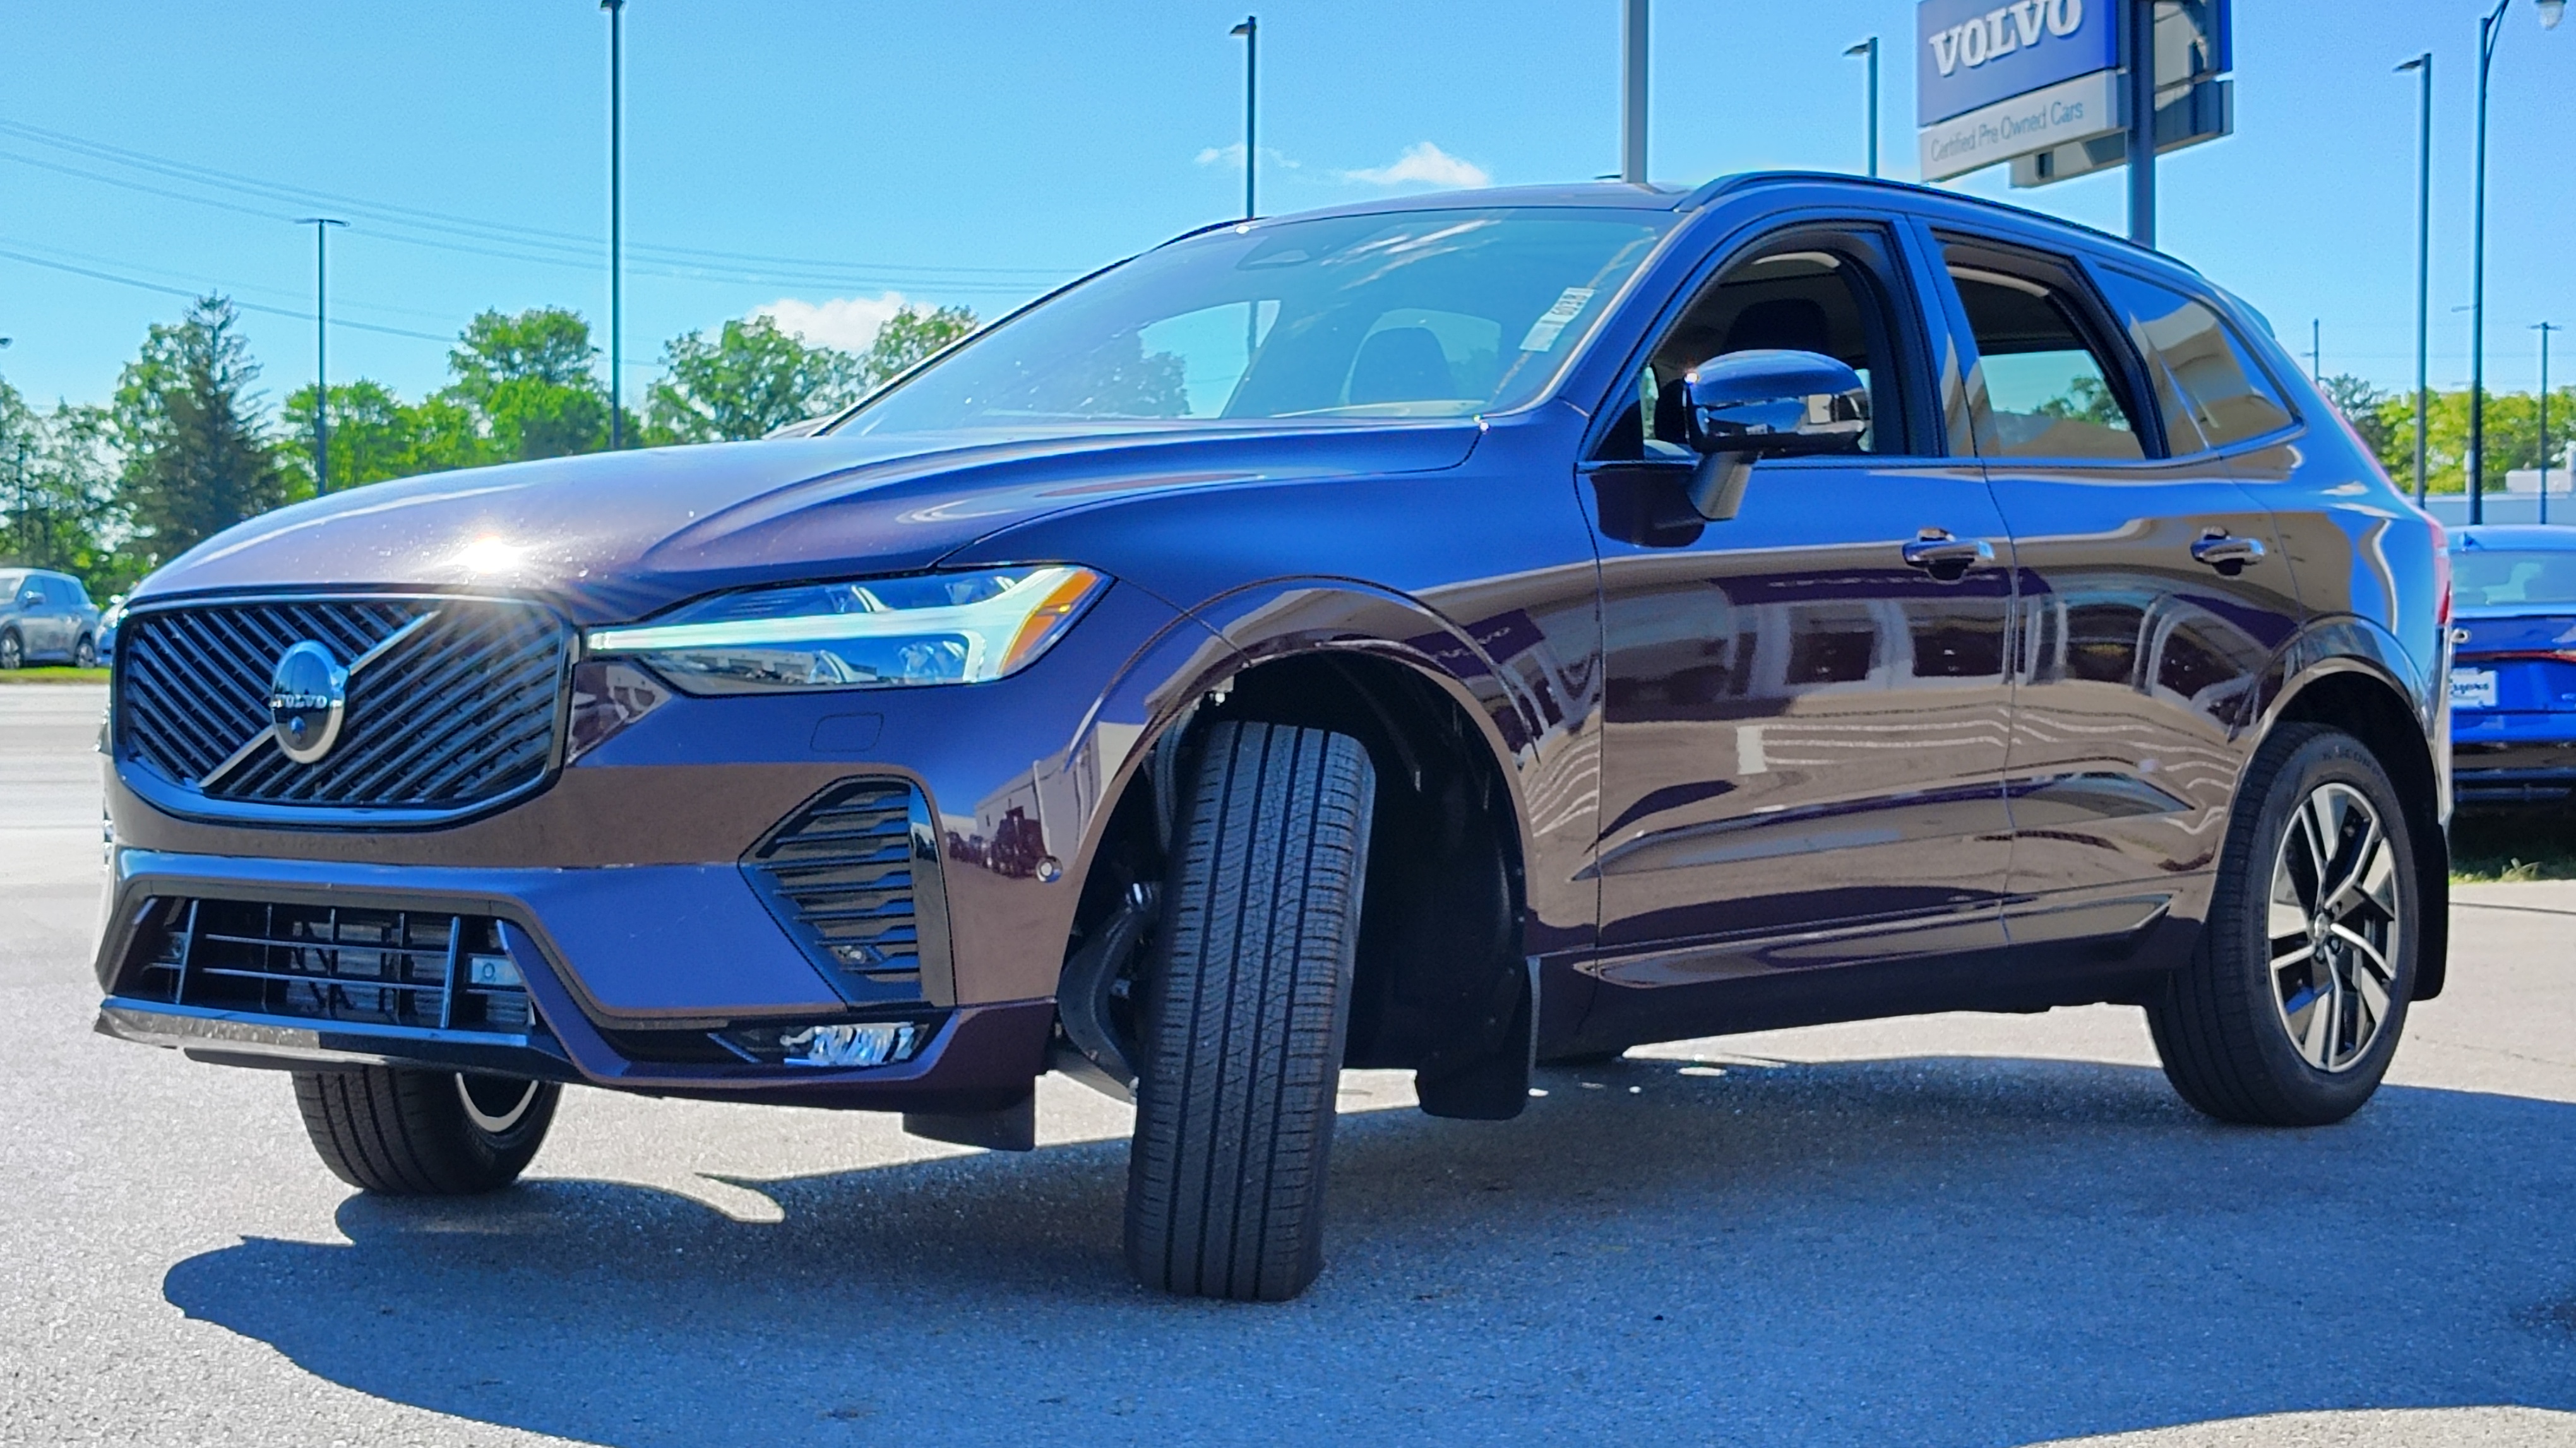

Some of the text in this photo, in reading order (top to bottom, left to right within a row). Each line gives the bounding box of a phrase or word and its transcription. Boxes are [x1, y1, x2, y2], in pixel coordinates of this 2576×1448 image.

[1928, 0, 2082, 76] VOLVO
[1930, 101, 2084, 162] Certified Pre Owned Cars
[275, 694, 328, 709] VOLVO
